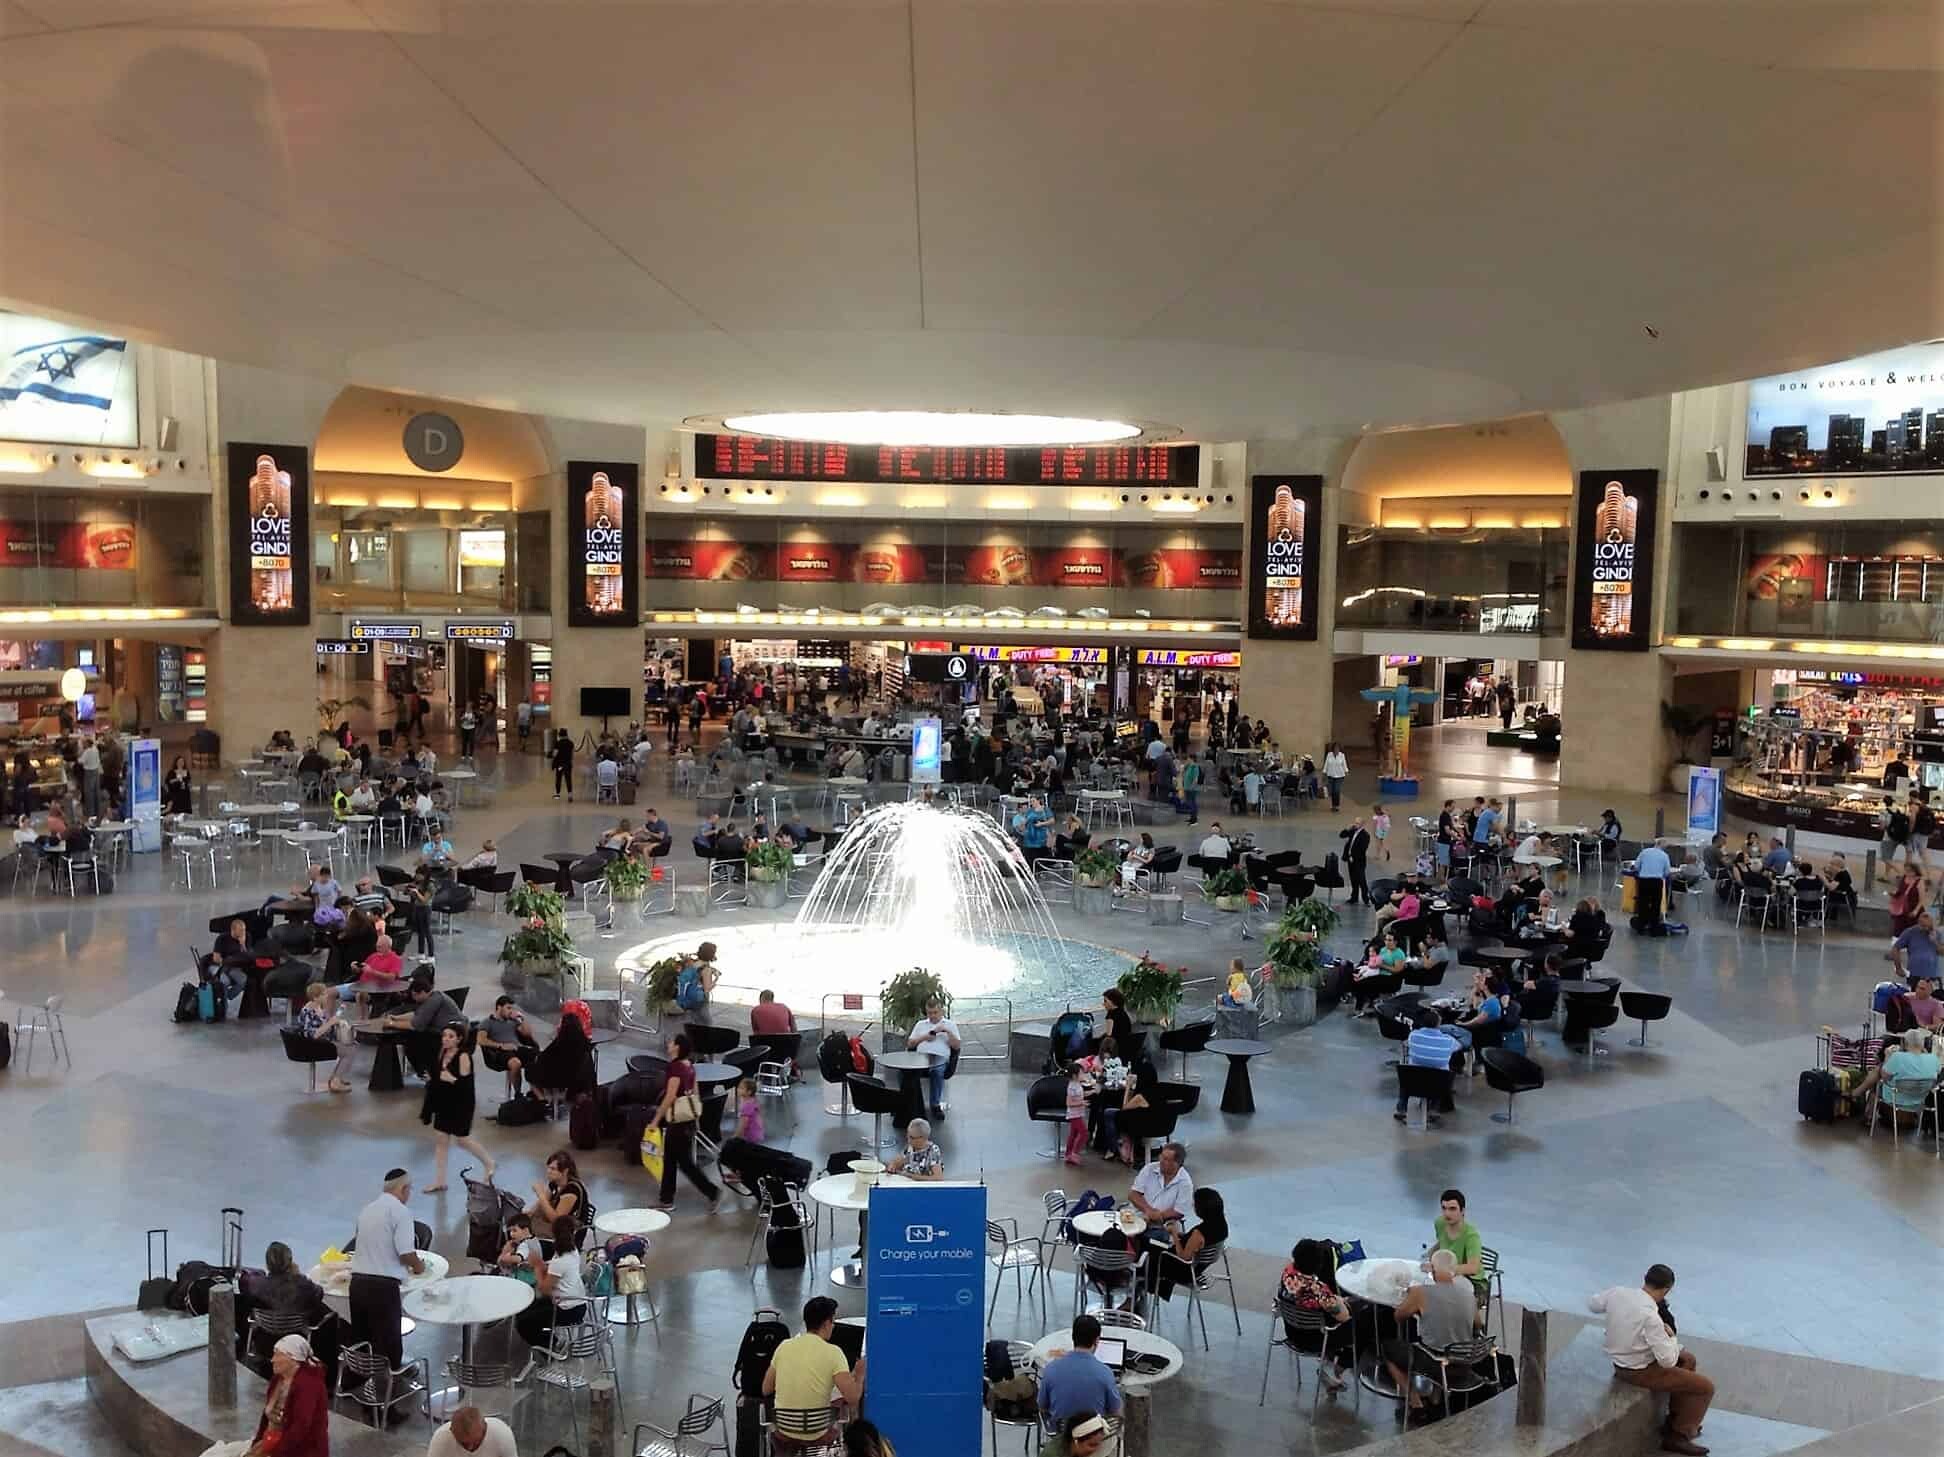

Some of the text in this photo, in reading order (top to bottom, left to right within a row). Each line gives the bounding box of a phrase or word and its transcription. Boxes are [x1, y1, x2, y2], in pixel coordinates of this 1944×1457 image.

[1779, 383, 1808, 391] BON
[1818, 377, 1877, 389] VOYAGE
[1886, 371, 1896, 384] &
[424, 428, 447, 455] D
[251, 517, 291, 534] LOVE
[586, 529, 622, 543] LOVE
[250, 541, 291, 555] GINDI
[1267, 542, 1303, 556] LOVE
[1594, 543, 1635, 559] LOVE
[585, 551, 622, 562] GINDI
[1266, 563, 1302, 575] GINDI
[1592, 567, 1633, 580] GINDI
[1011, 650, 1034, 661] DUTY
[1189, 655, 1211, 665] DUTY
[880, 1248, 974, 1261] Charge your mobile
